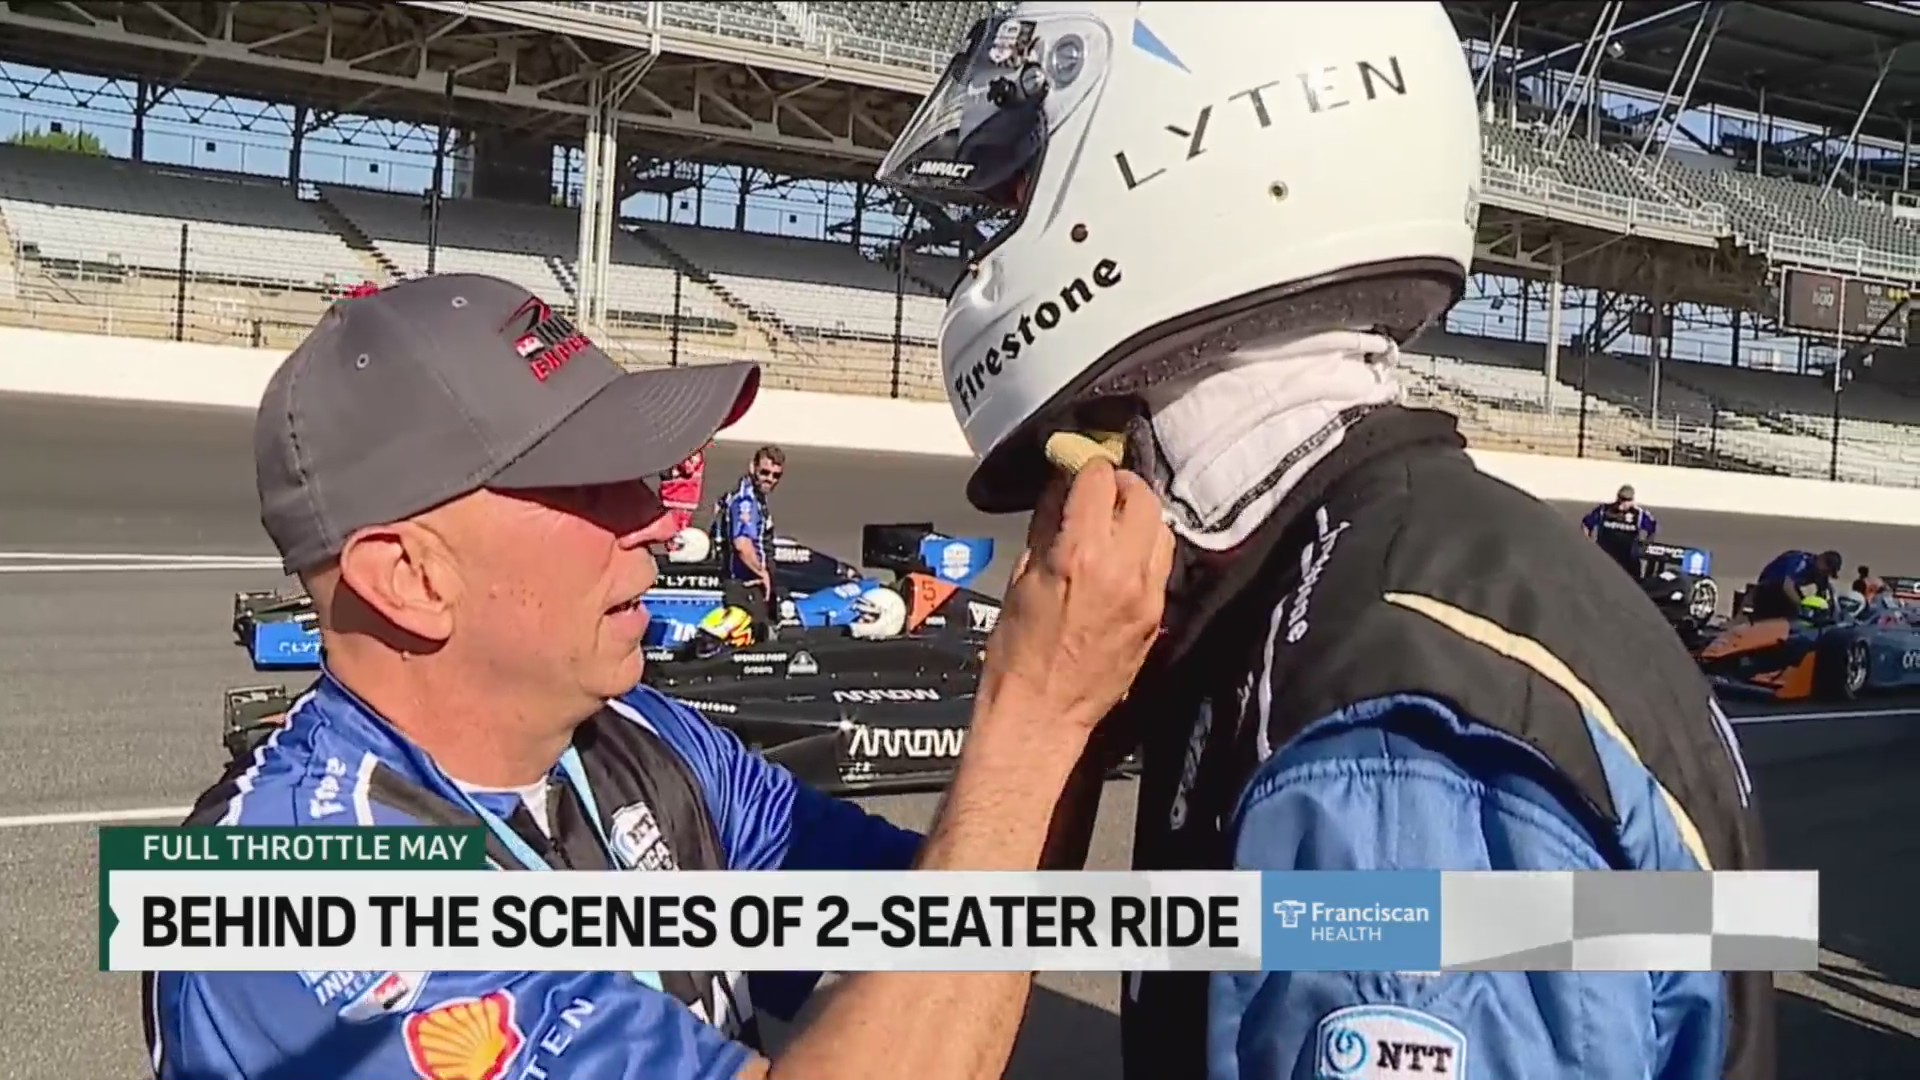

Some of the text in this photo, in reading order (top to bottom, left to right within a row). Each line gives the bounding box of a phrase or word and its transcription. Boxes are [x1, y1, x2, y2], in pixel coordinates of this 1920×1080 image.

[1115, 55, 1409, 191] LYTEN
[918, 160, 975, 178] IMPACT
[954, 257, 1122, 411] Firestone
[666, 575, 720, 588] LYTEN
[922, 580, 938, 602] 5
[848, 724, 964, 758] ARROW
[1376, 1039, 1453, 1074] NTT
